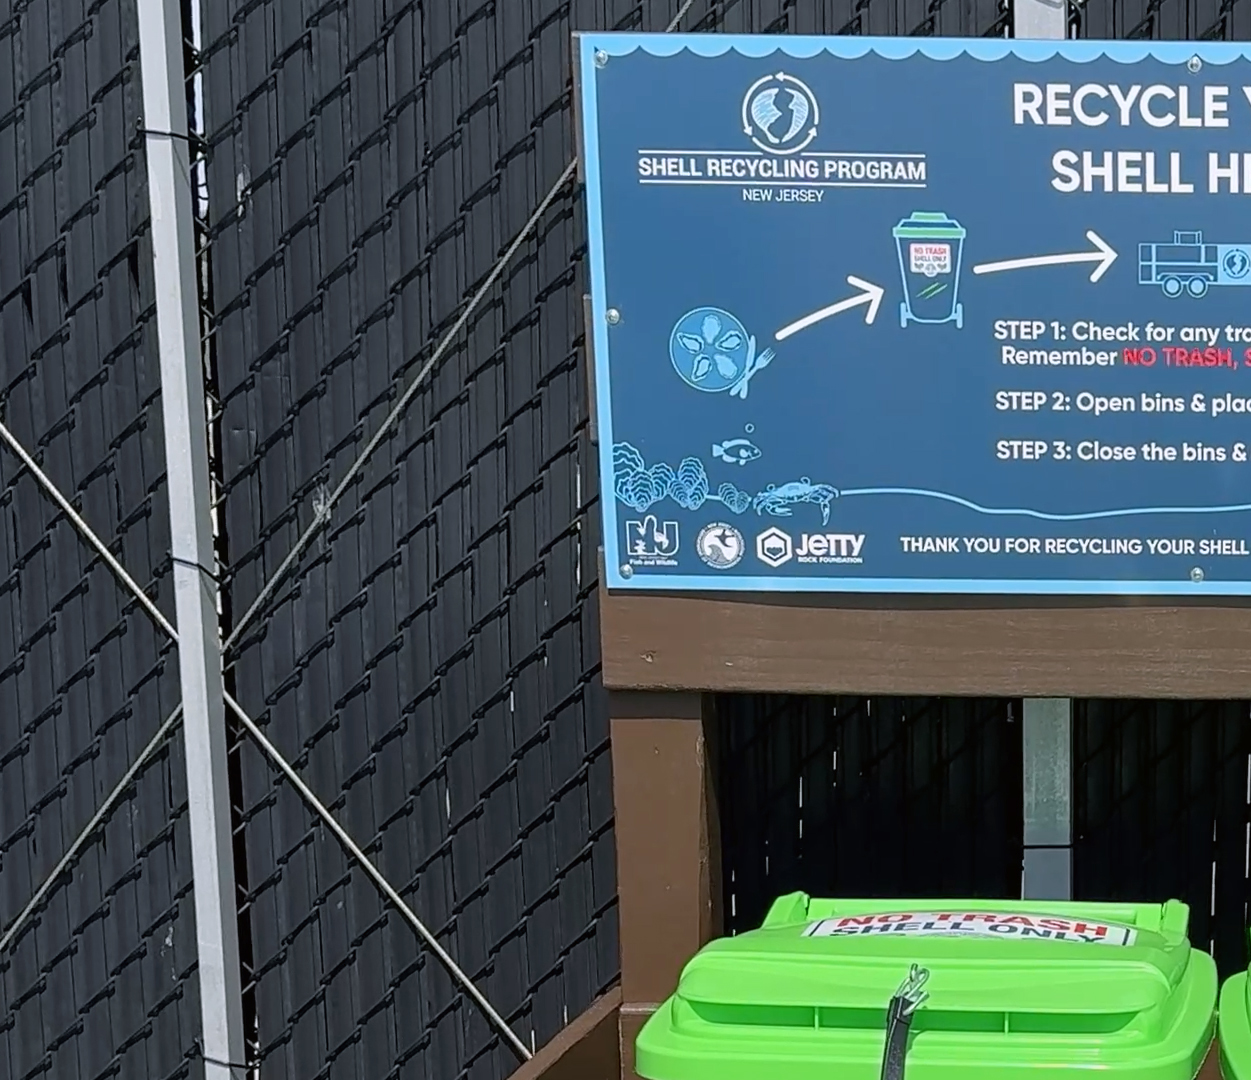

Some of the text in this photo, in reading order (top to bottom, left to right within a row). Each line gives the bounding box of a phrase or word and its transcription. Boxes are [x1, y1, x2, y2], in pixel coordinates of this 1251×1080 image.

[1014, 83, 1229, 127] RECYCLE
[639, 158, 927, 180] SHELL RECYCLING PROGRAM
[1051, 150, 1194, 193] SHELL
[743, 189, 823, 201] NEW JERSEY
[995, 321, 1045, 339] STEP
[1051, 322, 1066, 340] 1:
[1072, 322, 1139, 341] Check
[1145, 322, 1175, 341] for
[1180, 328, 1220, 346] any
[1002, 346, 1118, 365] Remember
[1122, 347, 1157, 366] NO
[1161, 347, 1239, 370] TRASH,
[996, 391, 1047, 410] STEP
[1052, 392, 1070, 410] 2:
[1077, 392, 1135, 415] Open
[1142, 393, 1184, 412] bins
[1191, 394, 1205, 412] &
[997, 441, 1047, 459] STEP
[1053, 442, 1071, 459] 3:
[1077, 441, 1136, 460] Close
[1141, 443, 1177, 460] the
[1183, 443, 1226, 461] bins
[1232, 443, 1246, 461] &
[900, 537, 959, 552] THANK
[963, 538, 1000, 552] YOU
[1005, 538, 1040, 553] FOR
[1045, 539, 1142, 554] RECYCLING
[1147, 539, 1194, 554] YOUR
[1200, 540, 1249, 554] SHELL
[831, 922, 1102, 942] SHELL ONLY
[837, 914, 1109, 936] NO TRASH
